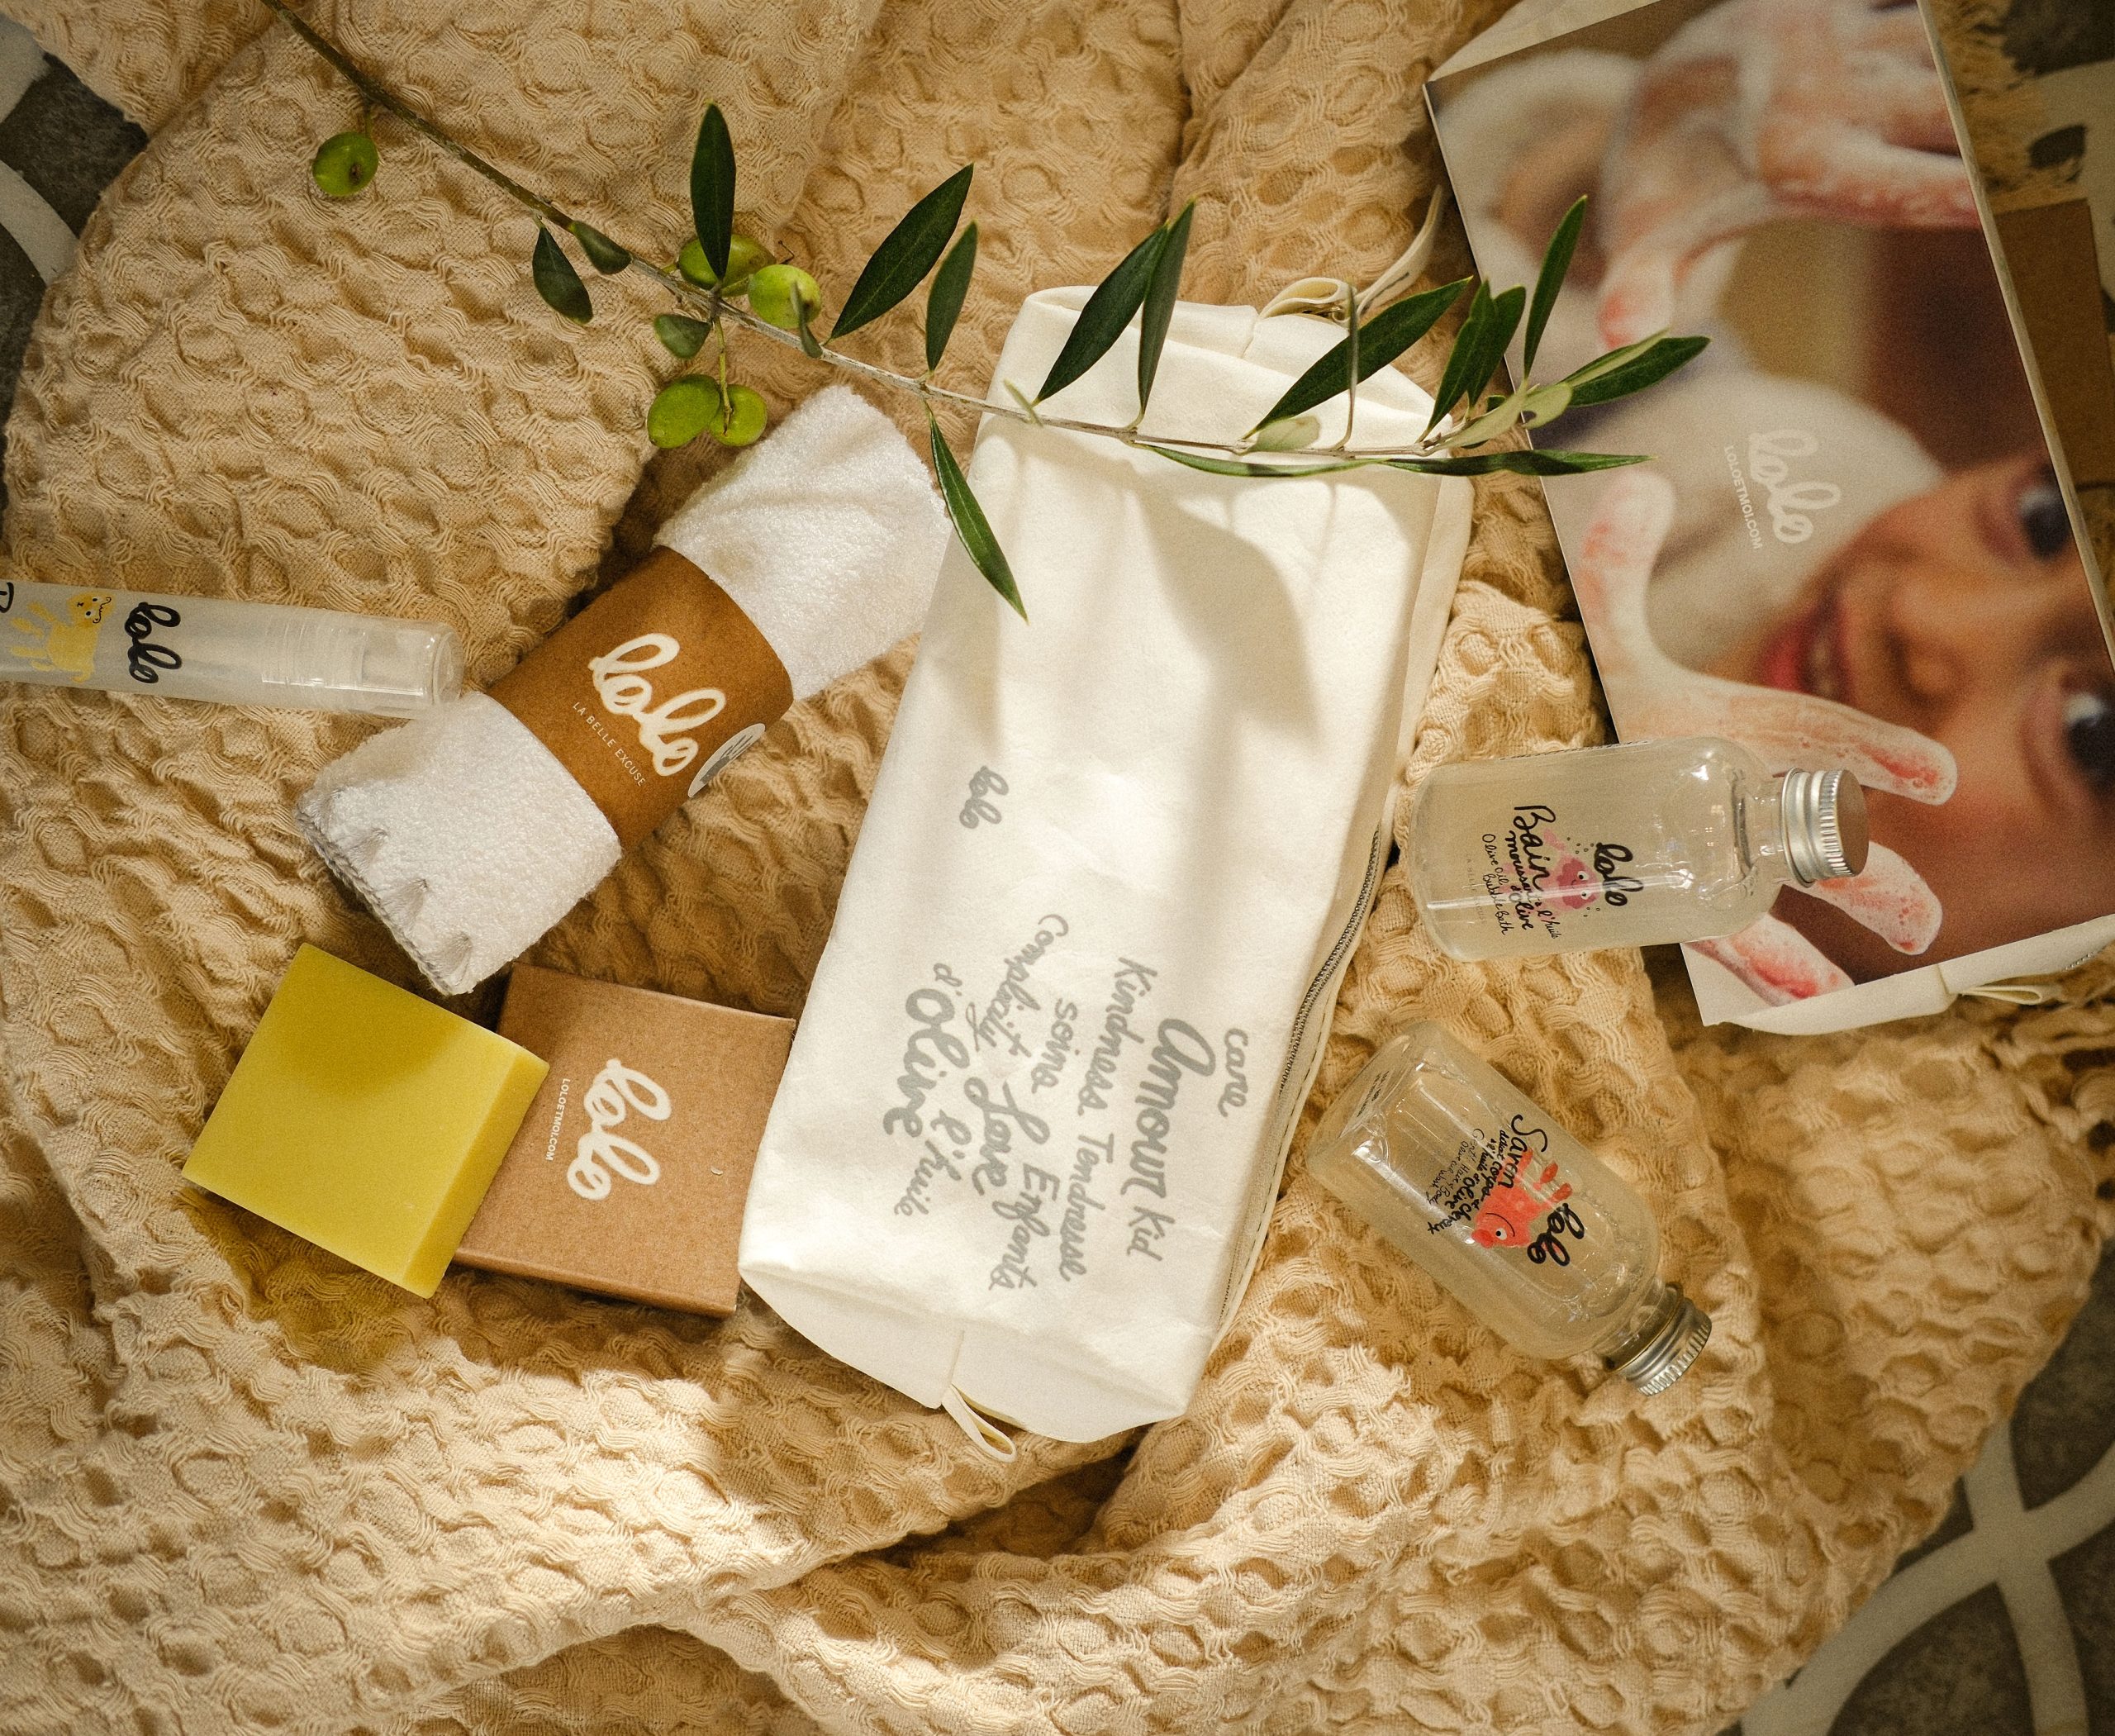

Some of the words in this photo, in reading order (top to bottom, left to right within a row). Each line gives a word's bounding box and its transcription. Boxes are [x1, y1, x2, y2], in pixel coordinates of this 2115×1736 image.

[1723, 445, 1763, 550] LOLOETMOI.COM
[1748, 429, 1842, 545] lolo
[125, 601, 183, 683] lolo
[573, 702, 587, 716] LA
[586, 715, 616, 748] BELLE
[615, 748, 646, 787] EXCUSE
[587, 633, 727, 777] lolo
[959, 765, 1010, 830] lolo
[1482, 833, 1499, 866] Olive
[1513, 805, 1557, 892] Bain
[1594, 842, 1644, 906] lolo
[1078, 957, 1157, 1116] Kindness
[1218, 1028, 1249, 1118] care
[545, 1078, 571, 1162] LOLOETMOI.COM
[567, 1058, 673, 1201] lolo
[963, 1076, 1051, 1196] Love
[1120, 1018, 1217, 1200] Amour
[1498, 1114, 1548, 1189] Savon
[989, 1163, 1060, 1291] Enfants
[1059, 1133, 1115, 1282] Tendresse
[1527, 1202, 1585, 1267] lolo
